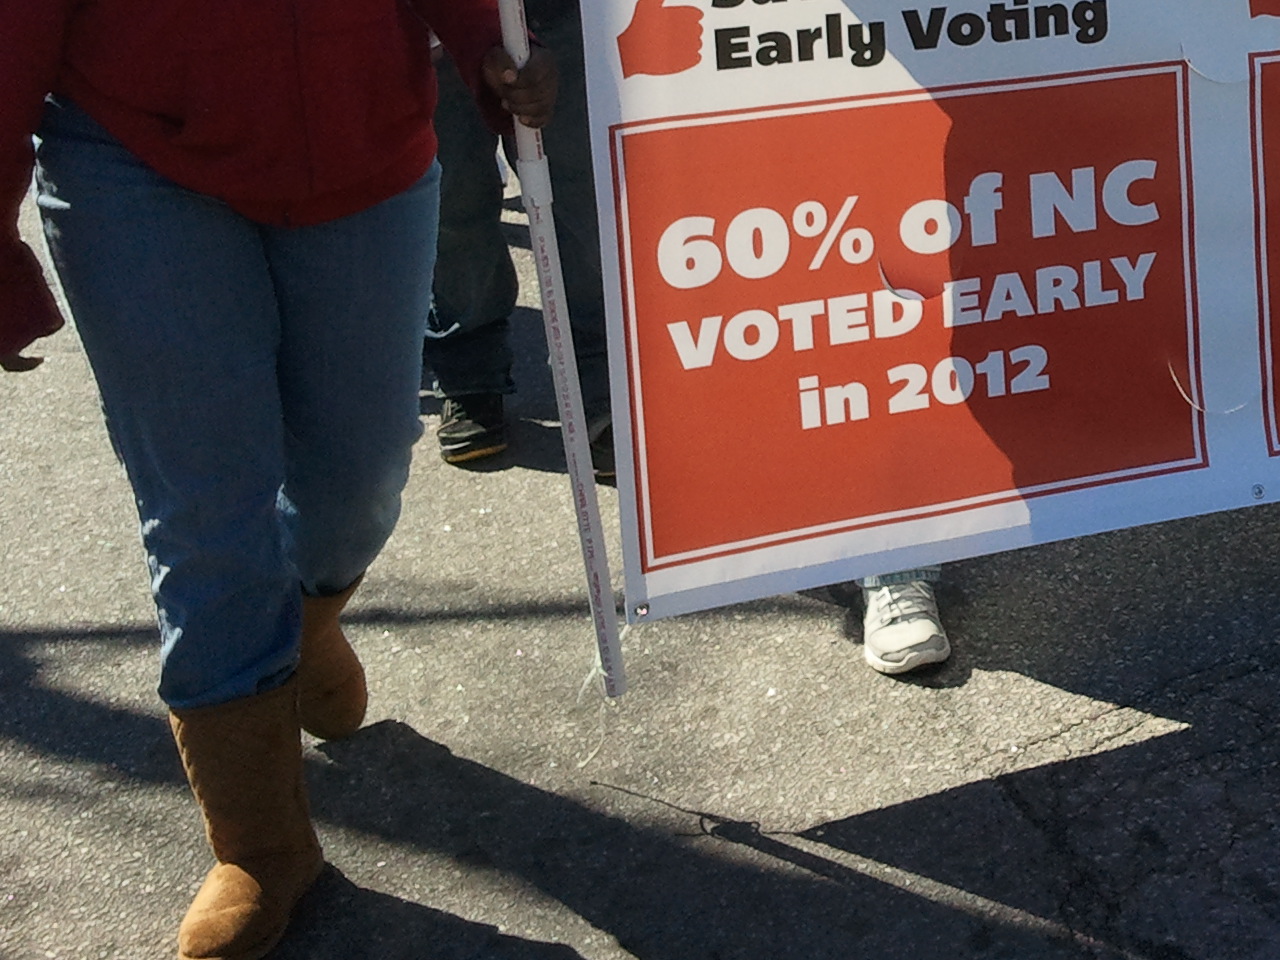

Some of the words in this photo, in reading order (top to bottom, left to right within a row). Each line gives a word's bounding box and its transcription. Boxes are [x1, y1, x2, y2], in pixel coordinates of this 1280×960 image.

[714, 13, 886, 72] Early
[656, 195, 875, 290] 60%
[899, 171, 1003, 256] of
[1028, 159, 1160, 239] NC
[667, 288, 924, 371] VOTED
[943, 252, 1157, 328] EARLY
[798, 375, 870, 430] in
[887, 345, 1050, 414] 2012
